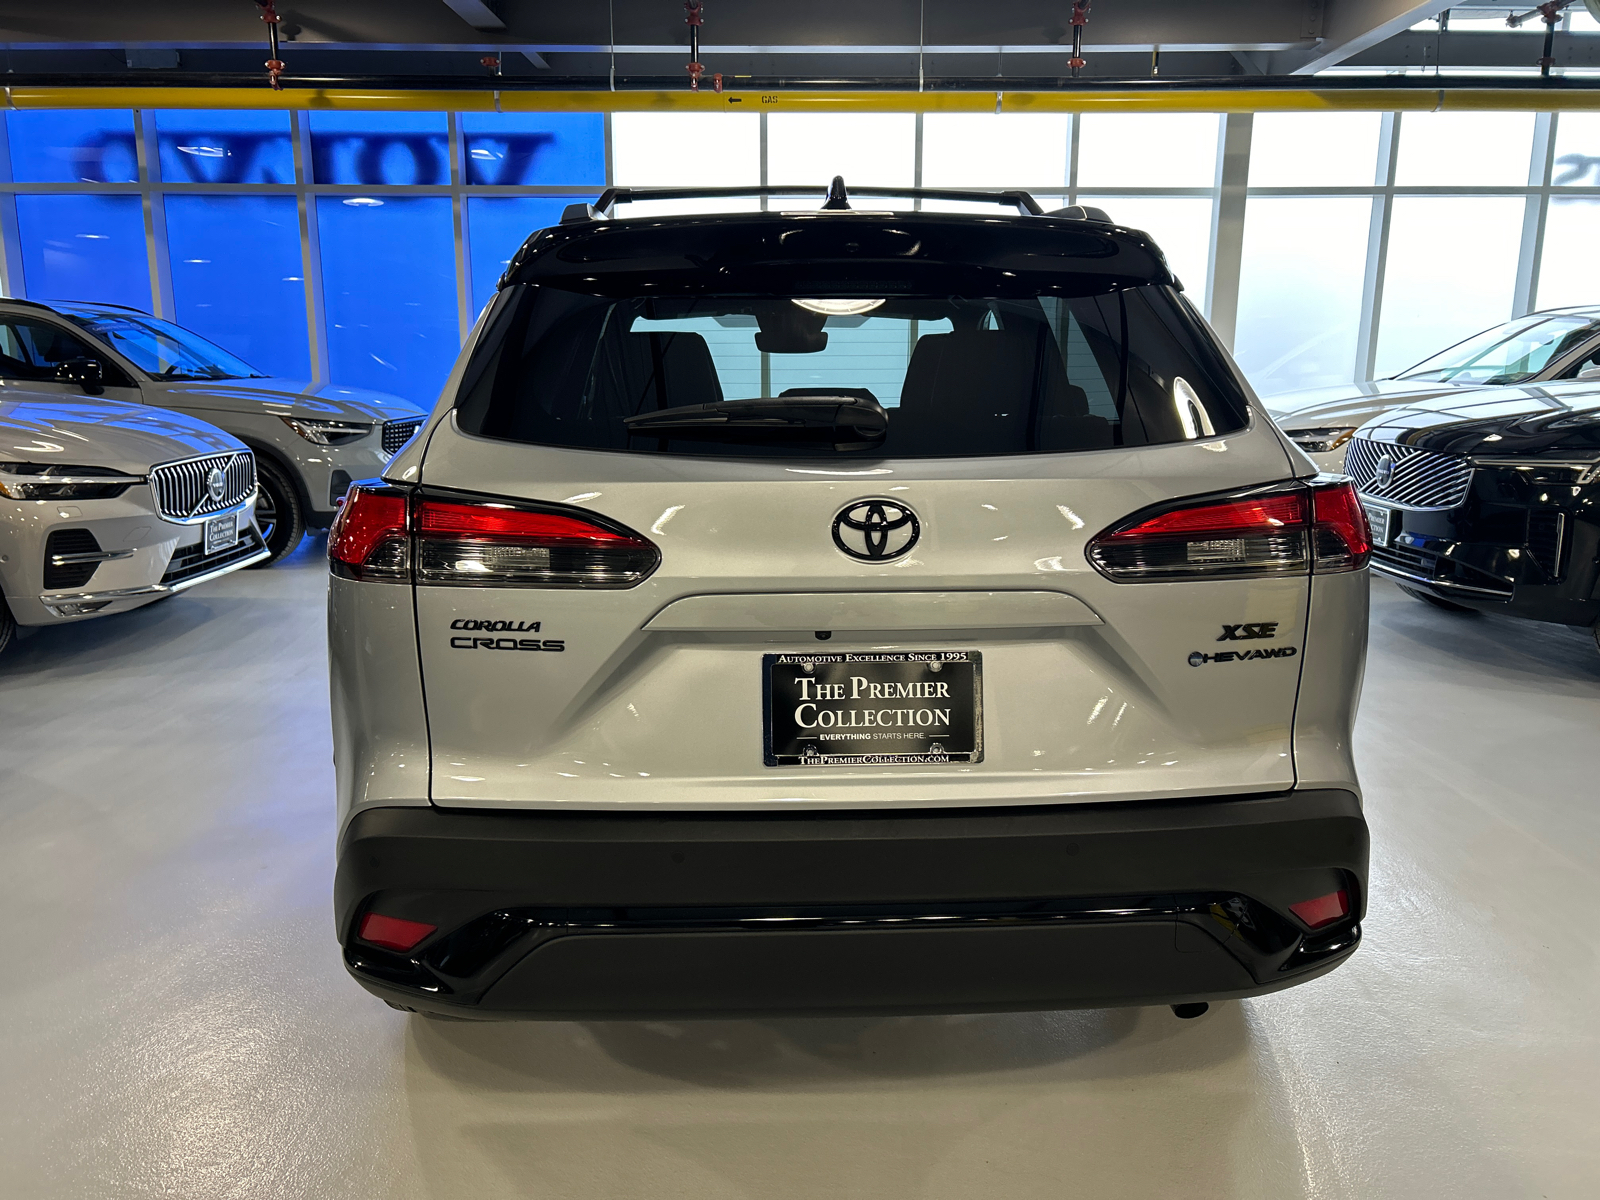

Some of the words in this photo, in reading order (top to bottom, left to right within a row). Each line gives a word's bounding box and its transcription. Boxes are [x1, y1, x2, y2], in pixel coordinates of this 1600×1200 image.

[761, 95, 778, 104] GAS
[209, 529, 234, 542] COLLECTION
[450, 619, 541, 632] COROLLA
[1216, 622, 1279, 641] XSE
[450, 637, 565, 652] CROSS
[778, 654, 843, 663] AUTOMOTIVE
[845, 653, 906, 662] EXCELLENCE
[908, 652, 937, 662] SINCE
[939, 652, 967, 661] 1995
[794, 677, 846, 701] THE
[850, 676, 951, 699] PREMIER
[794, 703, 951, 728] COLLECTION
[819, 733, 871, 741] EVERYTHING
[873, 732, 902, 740] STARTS
